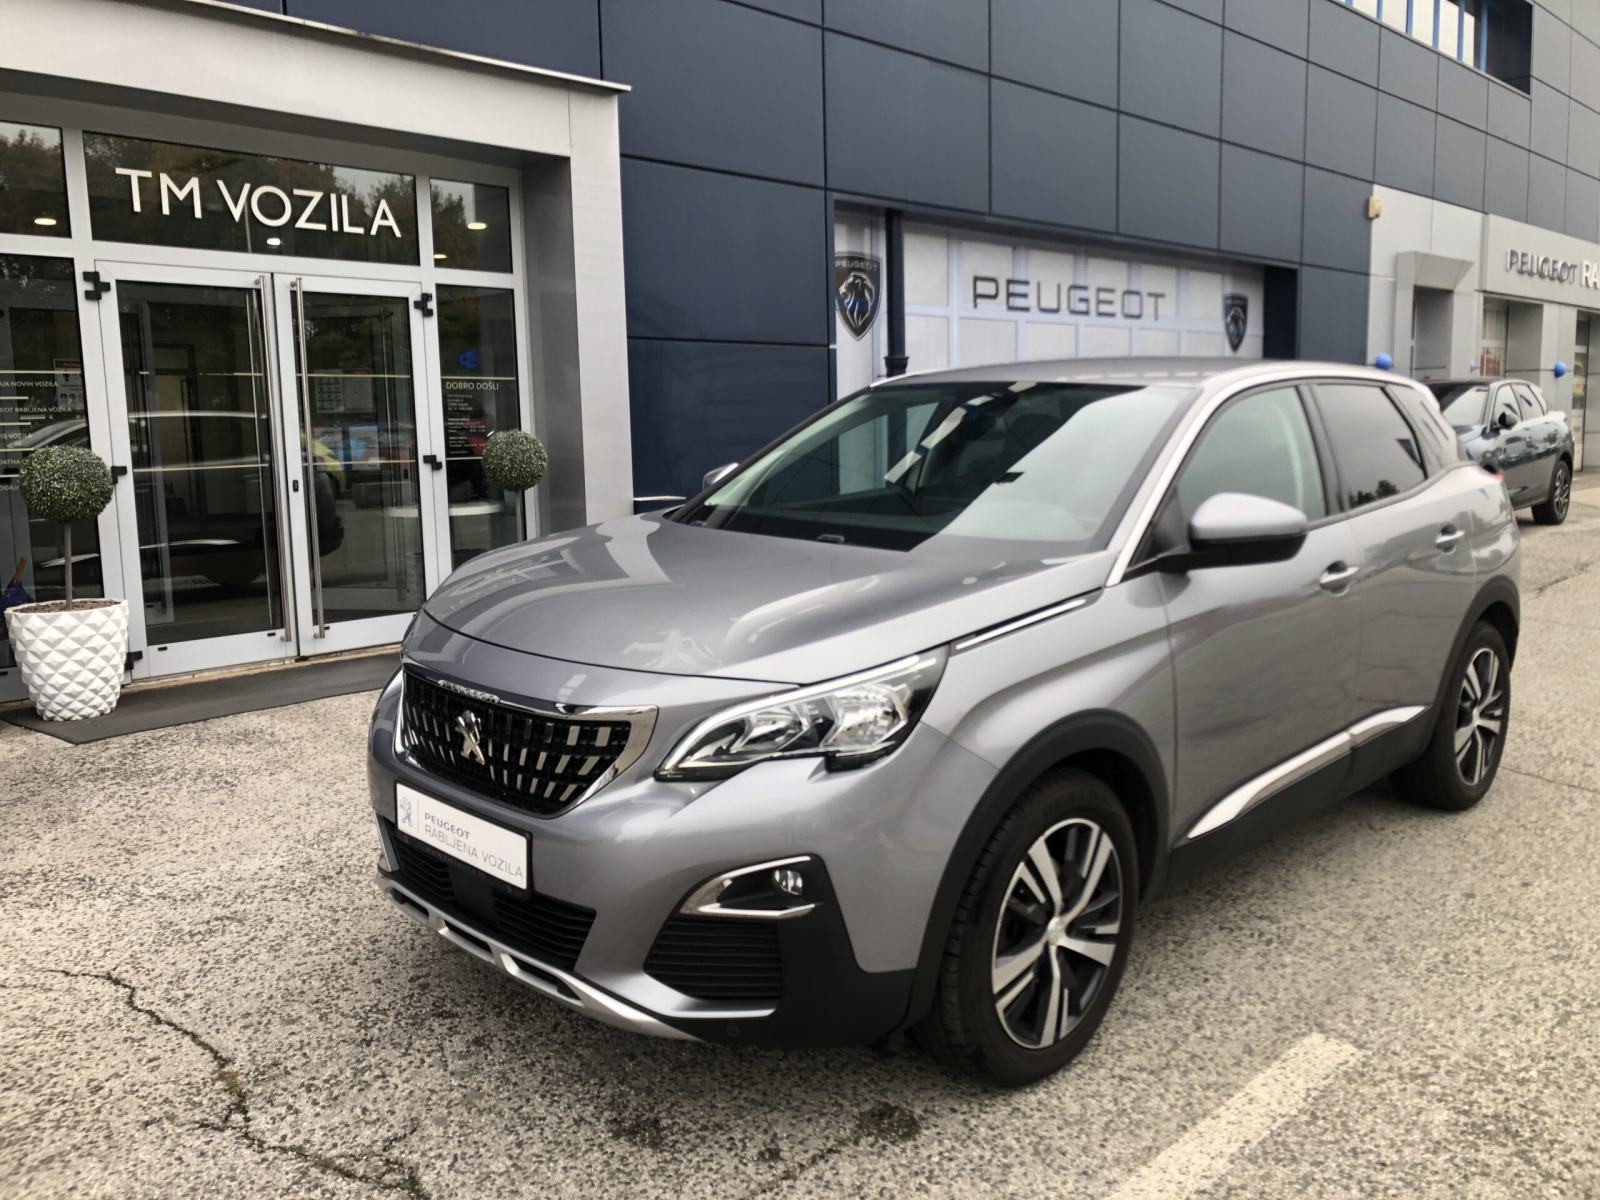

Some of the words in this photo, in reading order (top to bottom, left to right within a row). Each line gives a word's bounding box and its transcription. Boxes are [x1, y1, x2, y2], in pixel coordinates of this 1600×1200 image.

[115, 167, 202, 219] TM
[216, 179, 402, 238] VOZILA
[834, 260, 879, 271] PEUGEOT
[1506, 249, 1577, 285] PEUGEOT
[973, 275, 1166, 321] PEUGEOT
[446, 381, 475, 390] DOBRO
[476, 380, 499, 391] DOŠLI
[424, 812, 470, 840] PEUGEOT
[424, 824, 478, 858] RABLJENA
[480, 850, 523, 879] VOZILA
